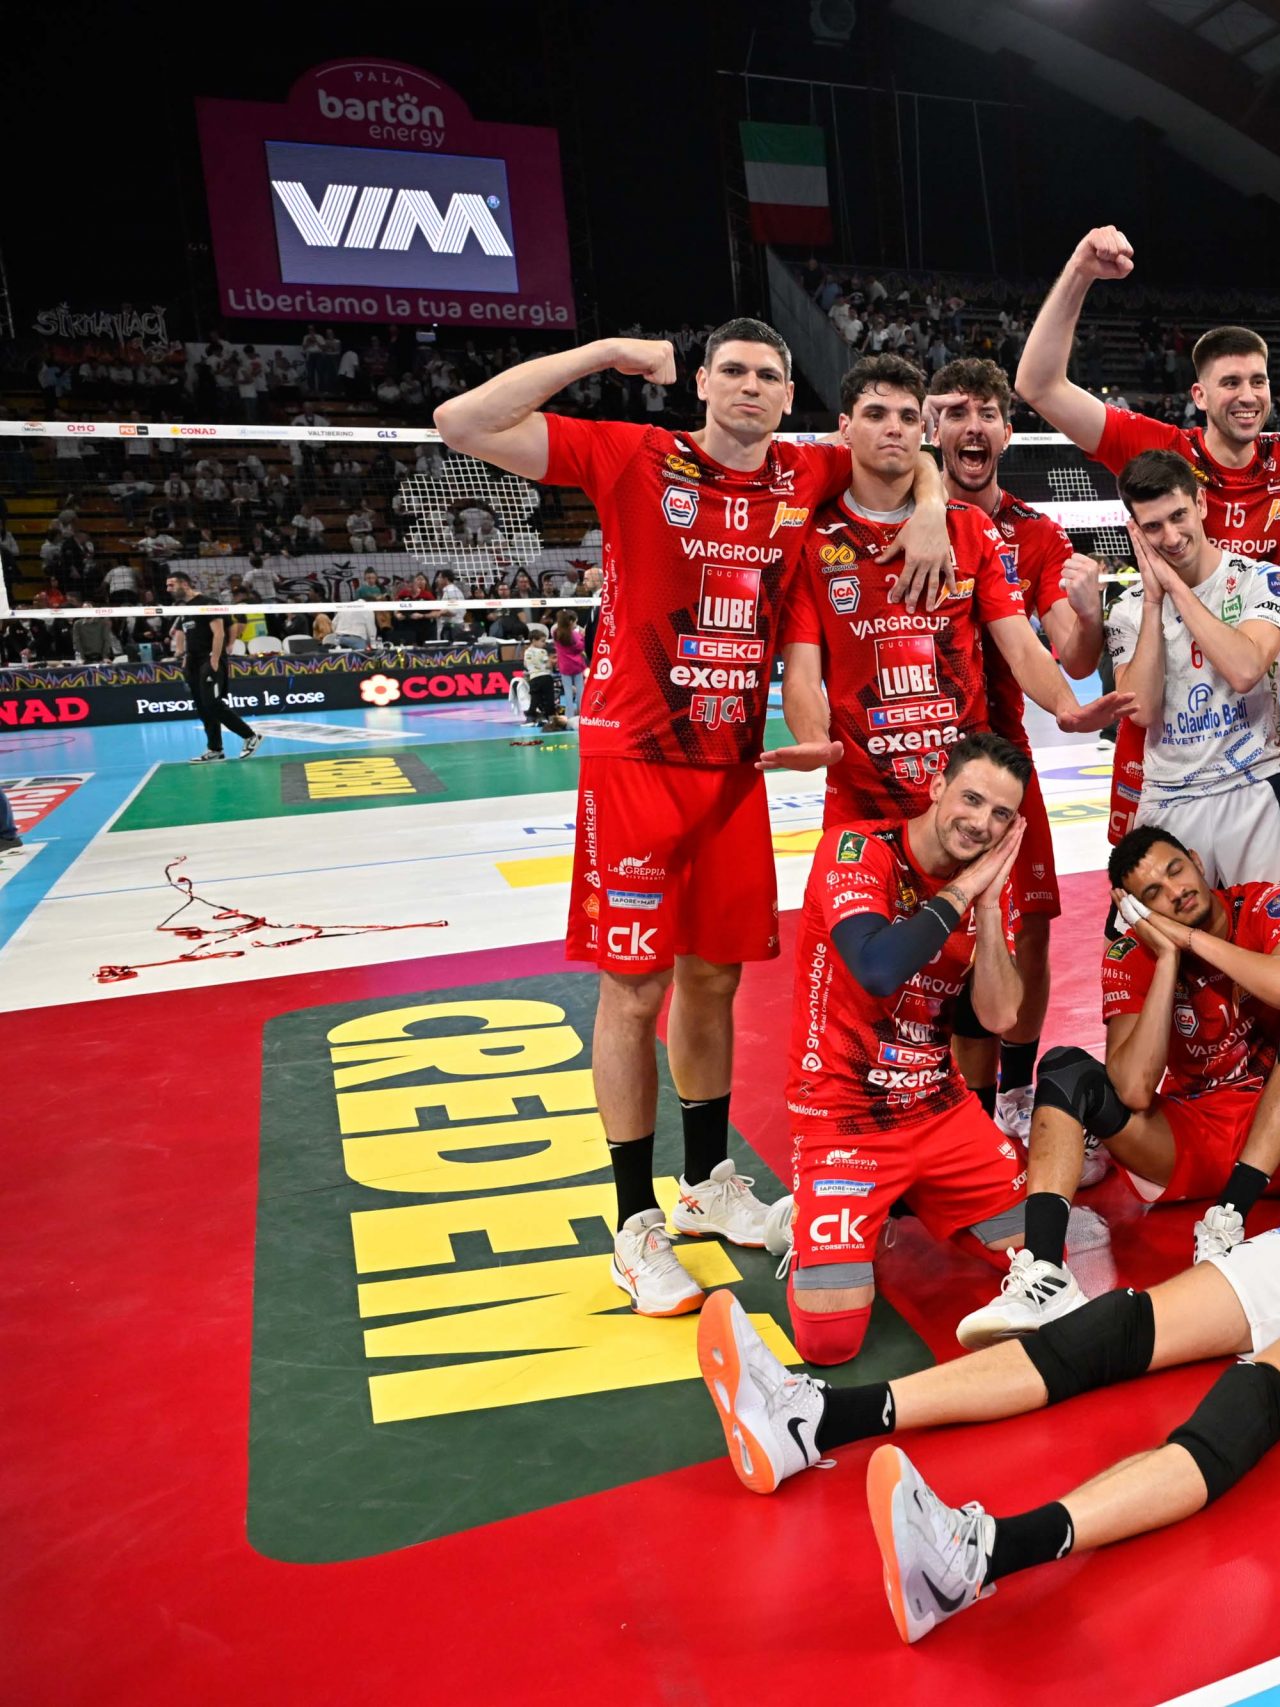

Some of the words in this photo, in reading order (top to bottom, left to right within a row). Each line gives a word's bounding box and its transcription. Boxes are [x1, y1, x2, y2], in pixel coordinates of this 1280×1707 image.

[353, 71, 405, 87] PALA
[369, 123, 445, 148] energy
[271, 180, 513, 257] VIM
[227, 287, 378, 316] Liberiamo
[386, 295, 411, 317] la
[419, 298, 462, 320] tua
[469, 301, 569, 327] energia
[181, 427, 217, 435] CONAD
[377, 430, 397, 439] GLS
[669, 496, 692, 511] ICA
[723, 496, 749, 531] 18
[1012, 505, 1038, 520] Hotpoint
[1224, 502, 1247, 528] 15
[680, 537, 783, 564] VARGROUP
[1207, 537, 1277, 553] RGROUP
[833, 587, 854, 598] ICA
[703, 596, 755, 629] LUBE
[849, 616, 950, 640] VARGROUP
[700, 640, 761, 658] GEKO
[402, 672, 523, 699] CONA
[883, 664, 935, 696] LUBE
[0, 697, 90, 725] NAD
[136, 698, 197, 715] Person
[264, 691, 280, 707] le
[286, 689, 326, 705] cose
[887, 702, 954, 724] GEKO
[1163, 717, 1177, 736] ng.
[1177, 705, 1220, 734] Claudio
[584, 790, 596, 867] adriaticaoli
[625, 867, 665, 876] GREPPIA
[806, 942, 827, 1049] greenbubble
[327, 998, 804, 1424] CREDEM
[809, 1208, 868, 1243] ck
